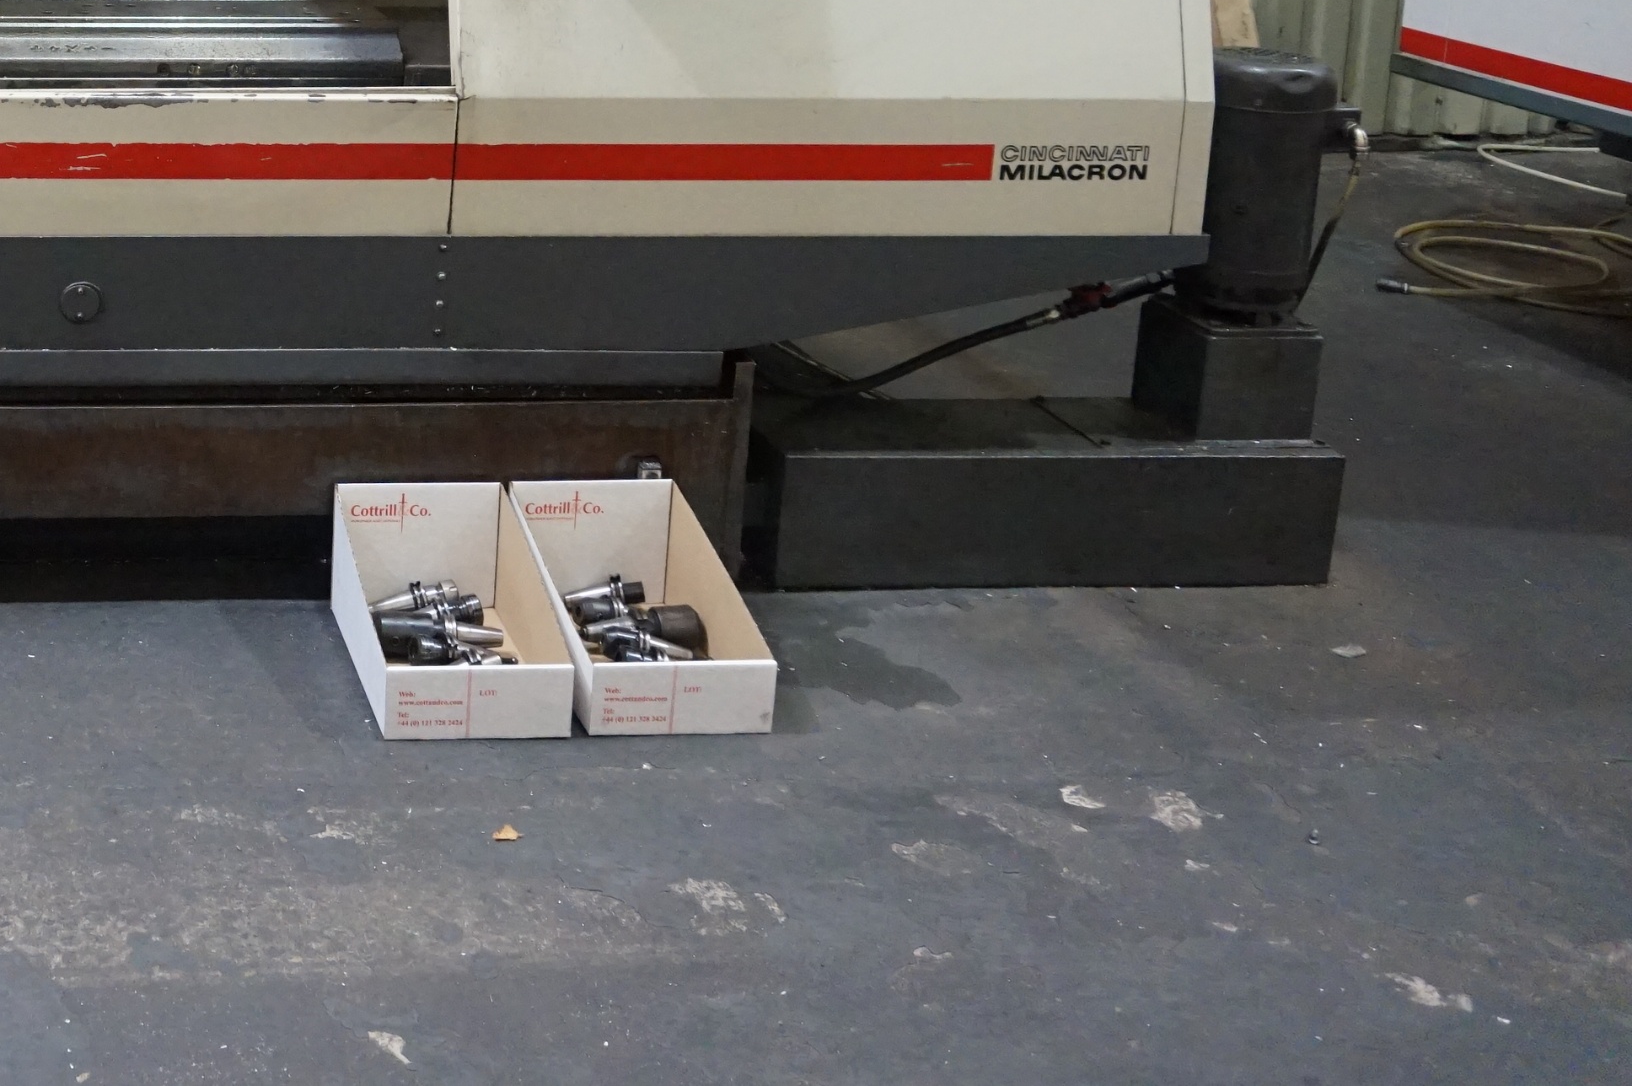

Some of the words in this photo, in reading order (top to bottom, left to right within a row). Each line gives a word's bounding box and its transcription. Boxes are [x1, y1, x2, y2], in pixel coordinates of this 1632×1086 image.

[1000, 144, 1150, 162] CINCINNATI
[999, 164, 1148, 181] MILACRON
[350, 503, 397, 517] Cottrill
[409, 504, 432, 517] Co.
[525, 501, 570, 515] Cottrill
[582, 501, 605, 514] Co.
